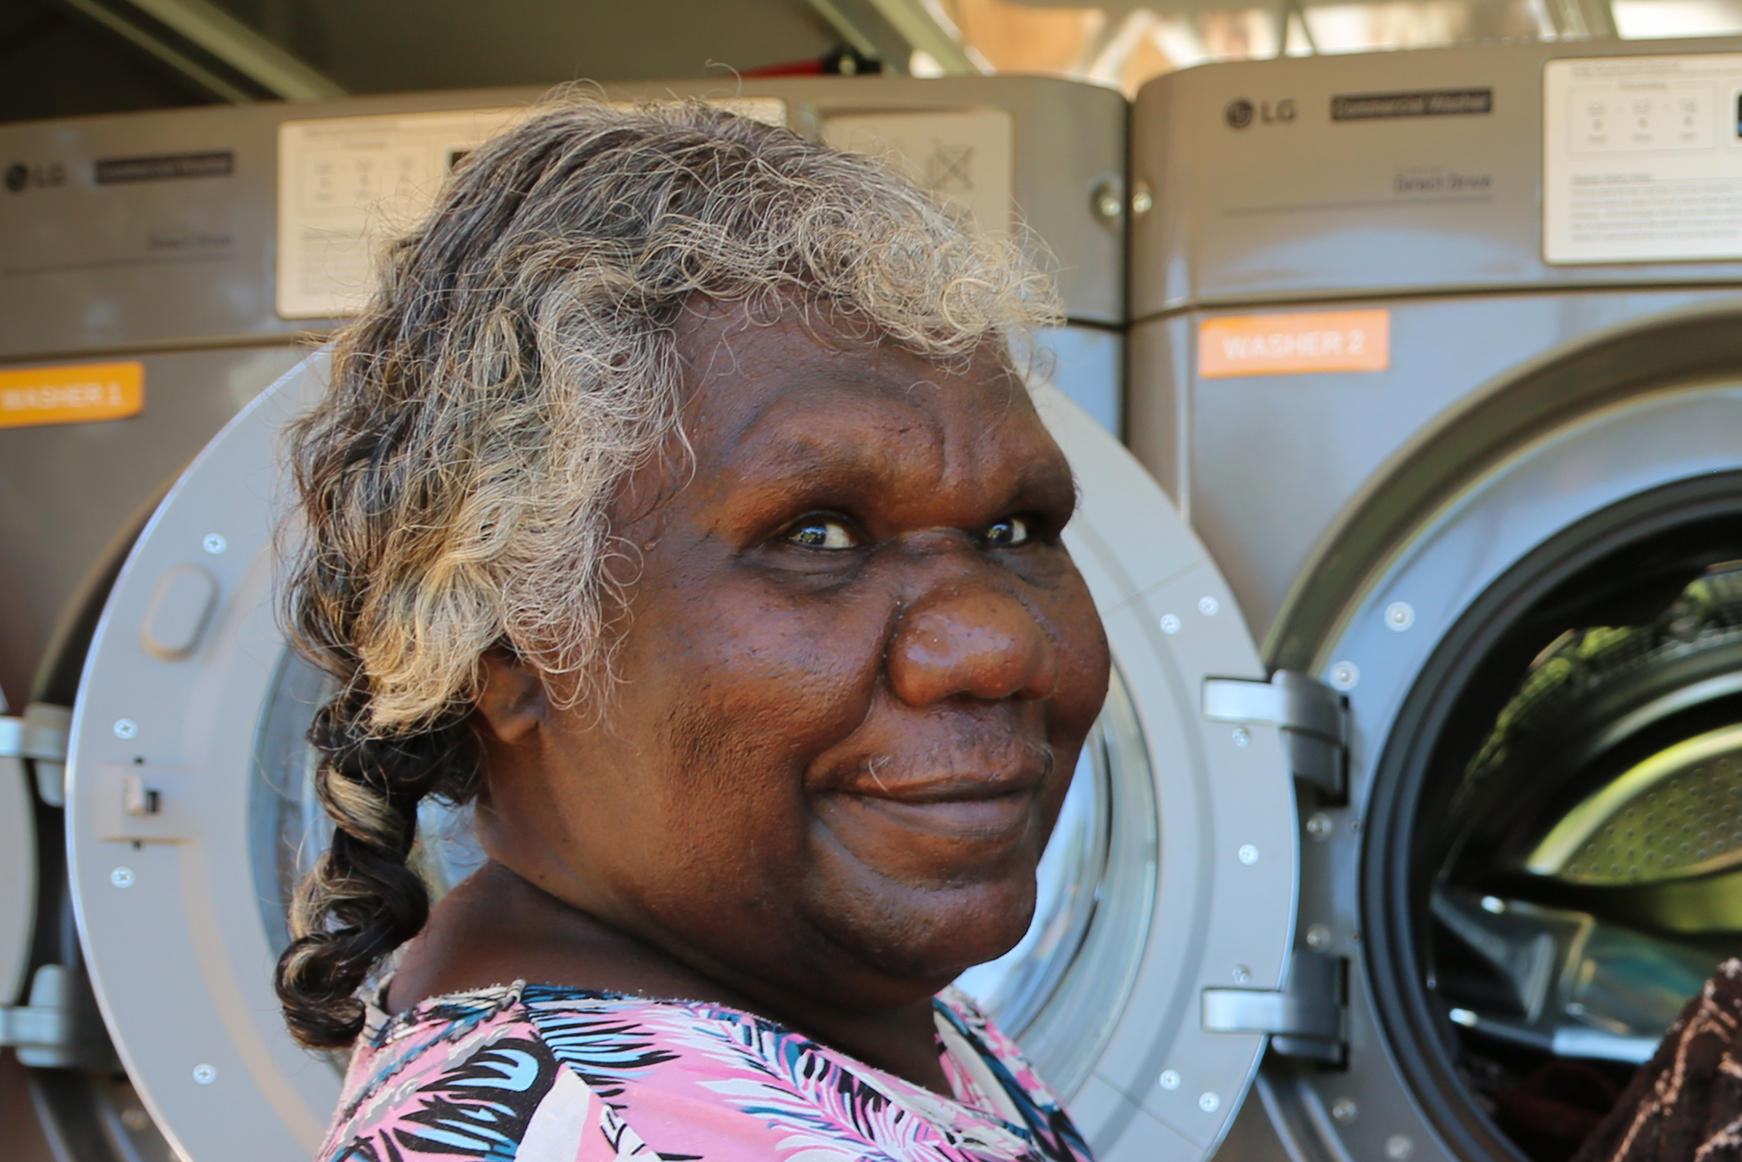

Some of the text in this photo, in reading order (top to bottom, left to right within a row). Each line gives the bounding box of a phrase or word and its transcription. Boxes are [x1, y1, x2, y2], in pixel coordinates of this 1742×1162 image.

[1260, 98, 1299, 125] LG
[1222, 329, 1366, 360] WASHER 2
